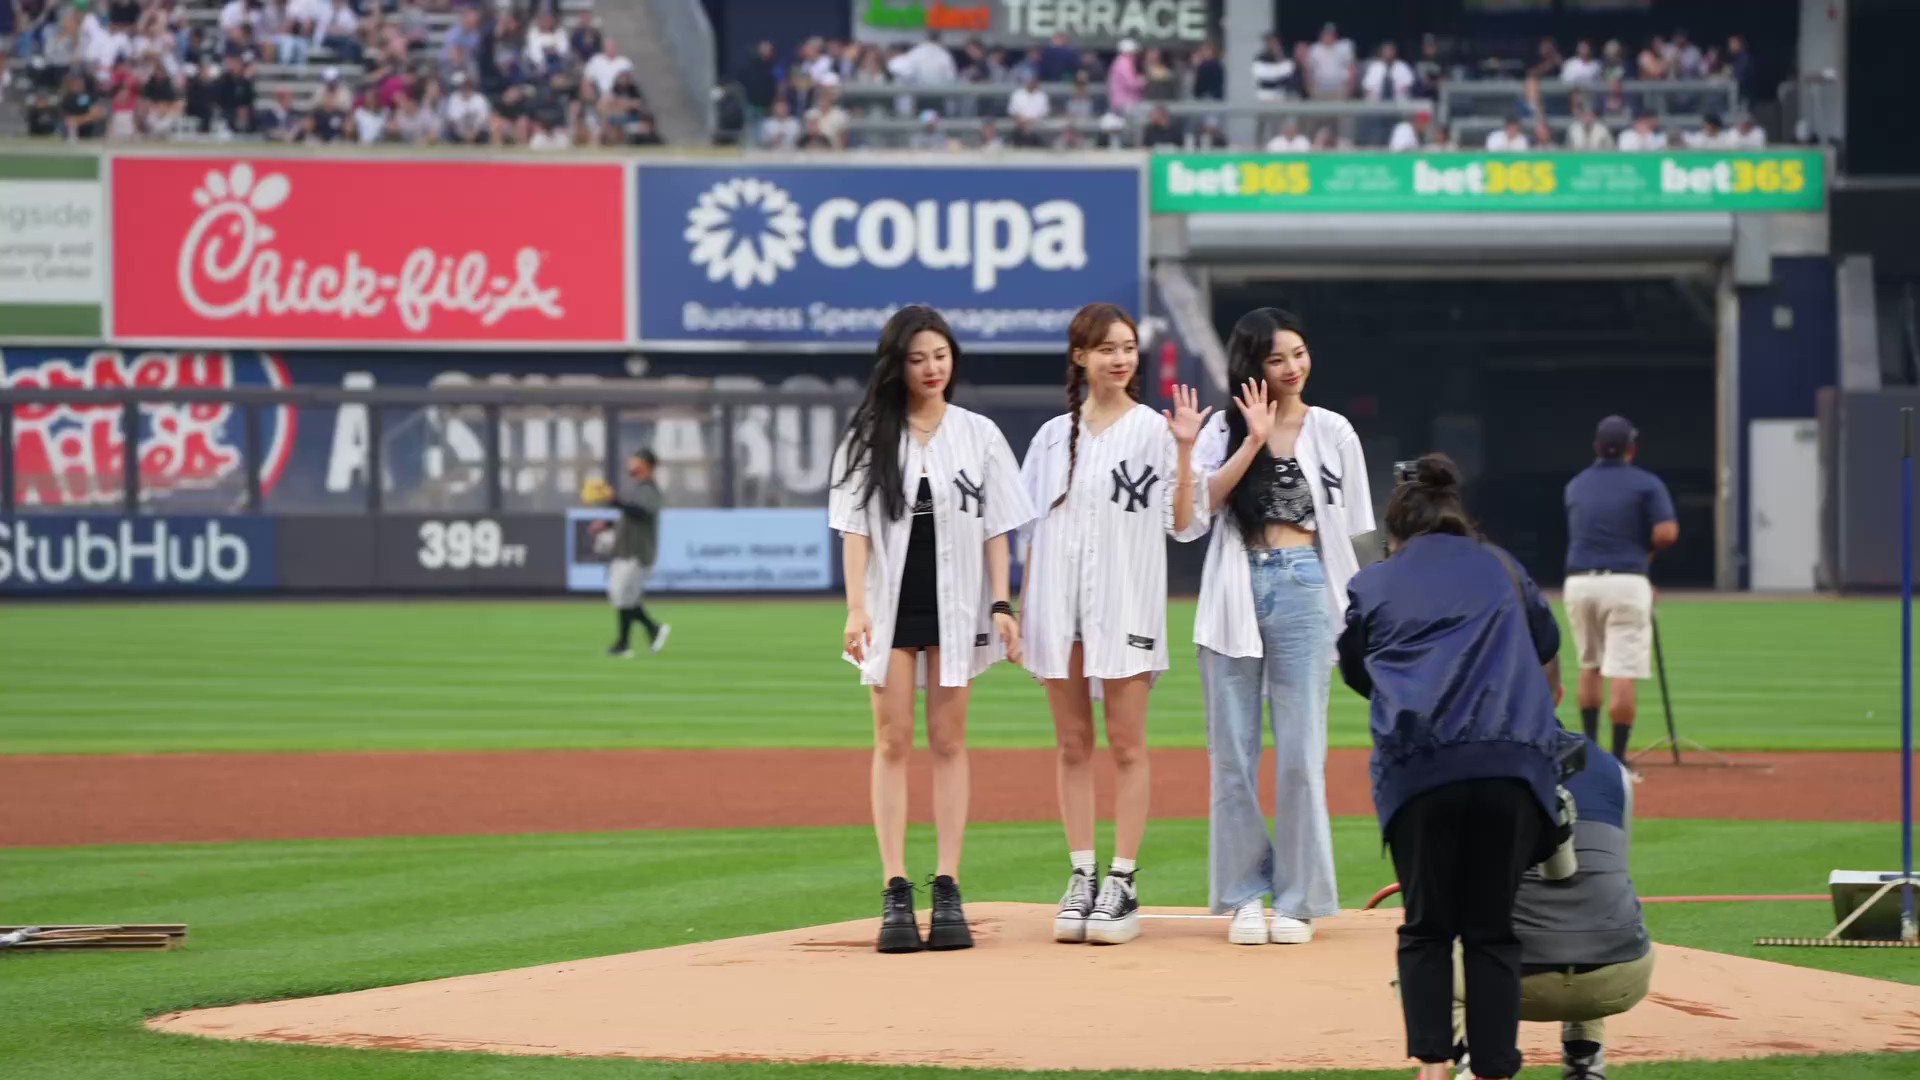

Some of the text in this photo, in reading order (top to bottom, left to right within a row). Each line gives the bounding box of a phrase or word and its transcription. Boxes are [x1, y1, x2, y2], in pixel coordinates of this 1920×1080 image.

[1002, 0, 1208, 40] TERRACE
[1167, 160, 1311, 196] bet365
[1414, 160, 1557, 196] bet365
[1661, 158, 1804, 194] bet365
[178, 199, 566, 332] Chick-fil-A
[808, 197, 1089, 293] coupa
[1110, 459, 1160, 513] NY
[417, 519, 502, 569] 399
